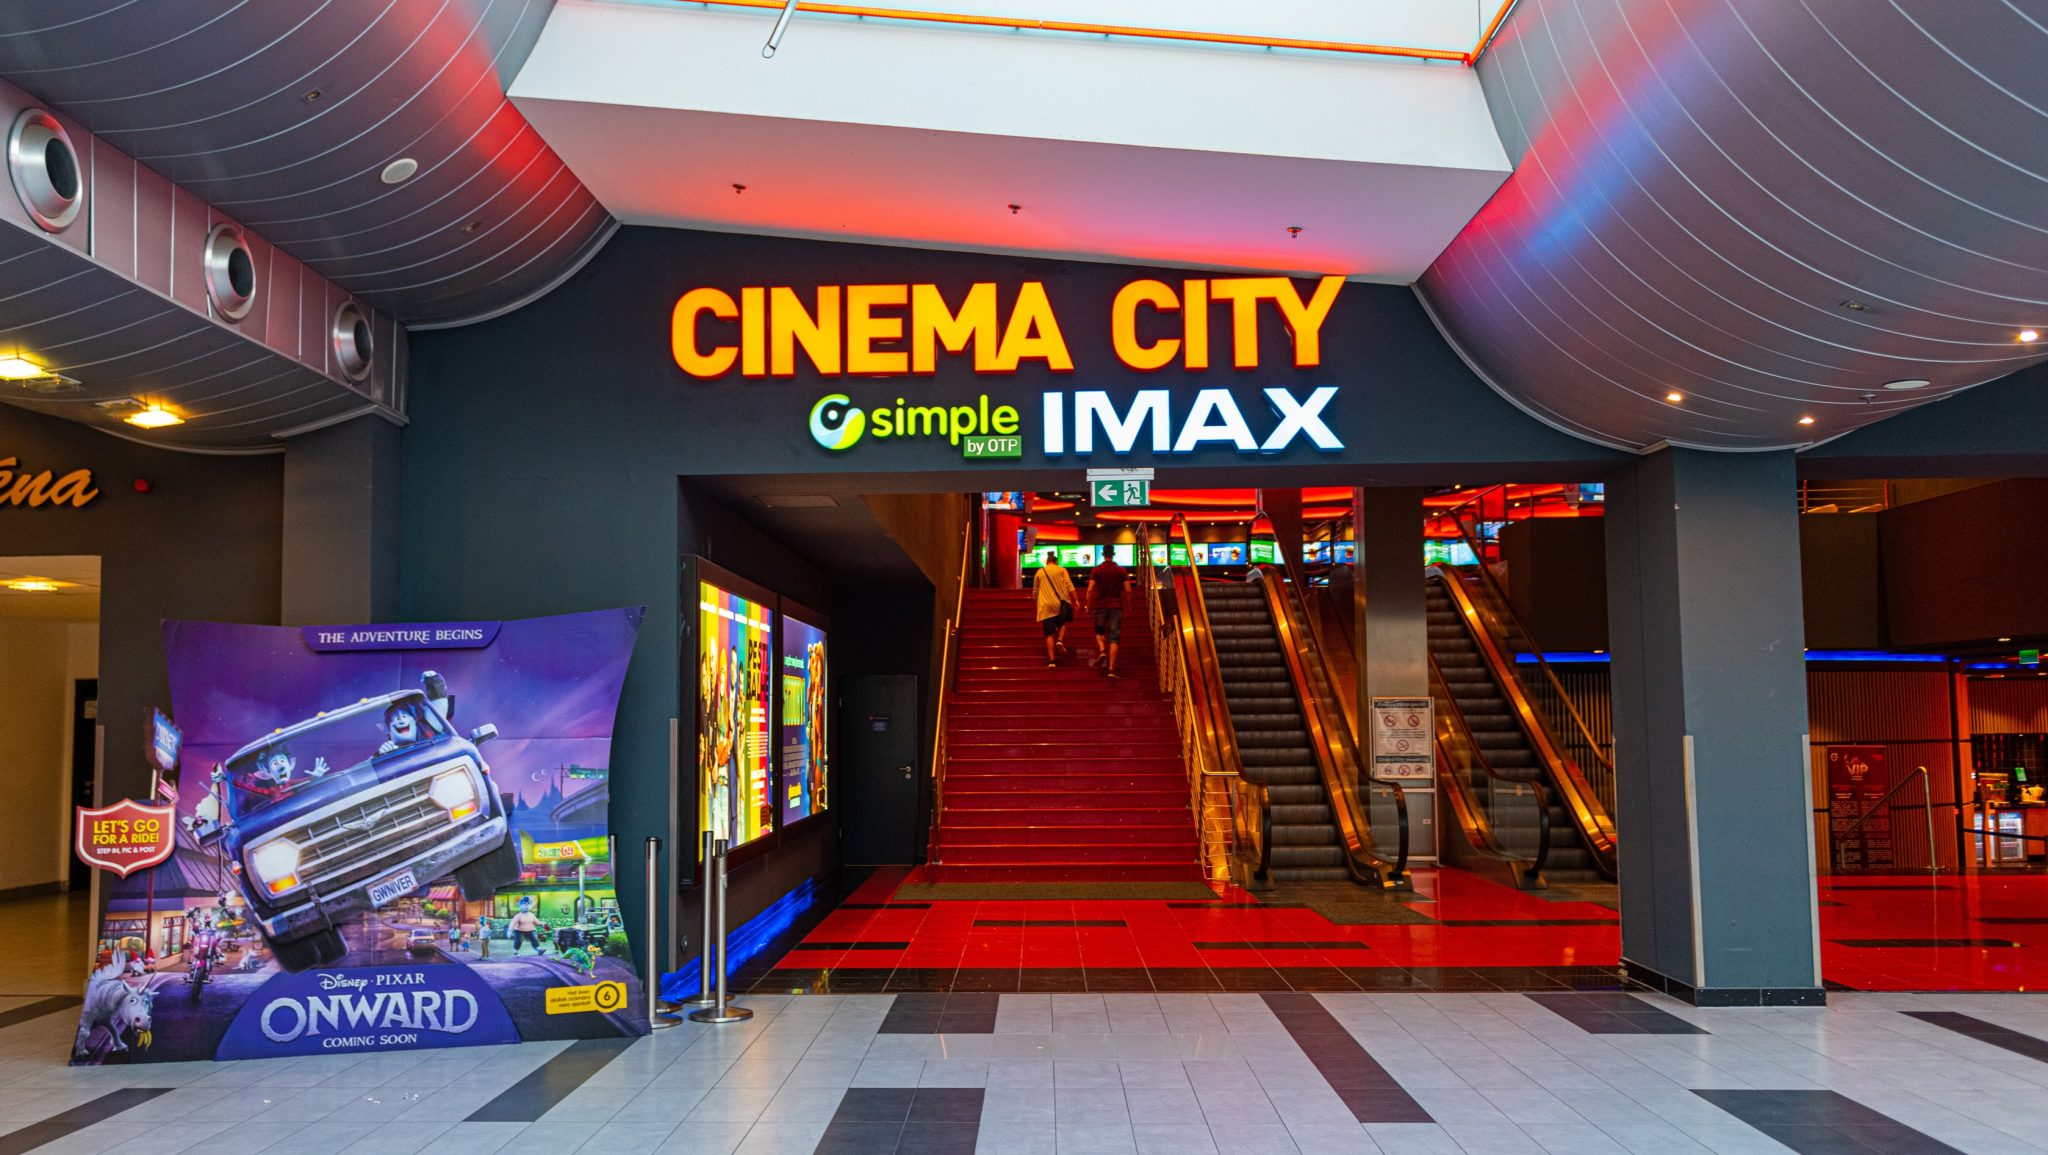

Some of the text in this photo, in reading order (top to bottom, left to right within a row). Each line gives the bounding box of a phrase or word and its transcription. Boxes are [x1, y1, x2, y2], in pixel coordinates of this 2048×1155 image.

[671, 275, 1347, 377] CINEMA CITY
[871, 394, 1019, 446] simple
[1043, 387, 1346, 455] IMAX
[966, 439, 1018, 455] by OTP
[318, 629, 483, 644] THE ADVENTURE BEGINS
[94, 819, 160, 833] LET'S GO
[93, 833, 159, 845] FOR A RIDE!
[373, 875, 414, 902] GWNIVER
[317, 973, 426, 992] Disney PIXAR
[603, 991, 611, 1001] 6
[261, 989, 479, 1042] ONWARD
[323, 1034, 417, 1048] COMING SOON
